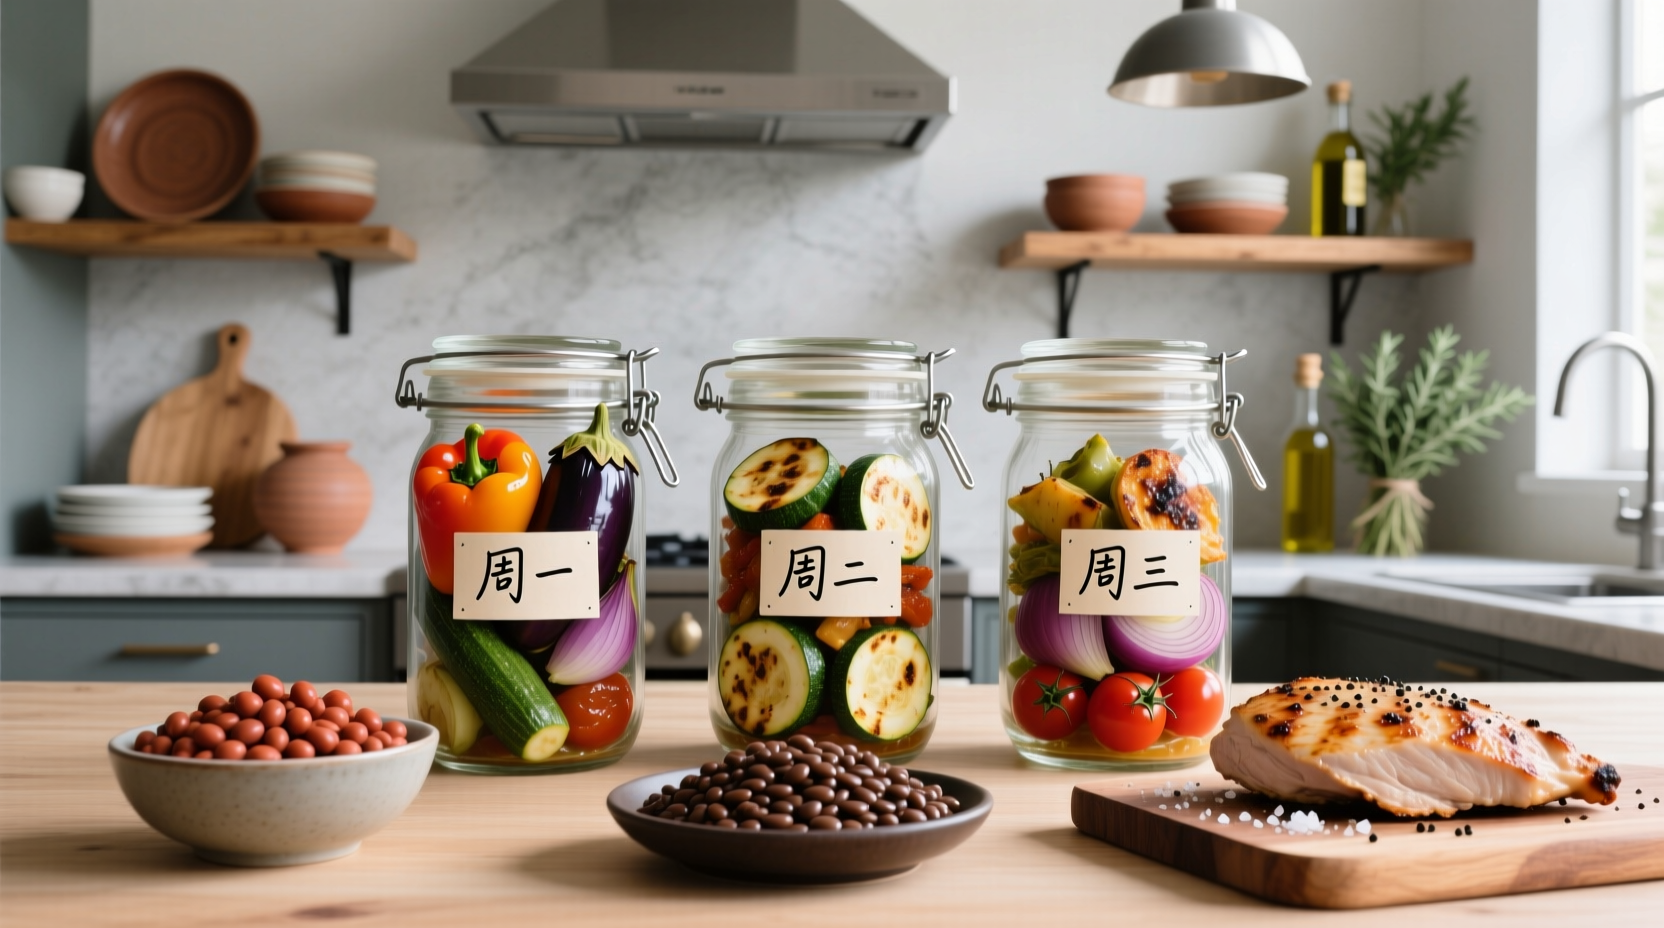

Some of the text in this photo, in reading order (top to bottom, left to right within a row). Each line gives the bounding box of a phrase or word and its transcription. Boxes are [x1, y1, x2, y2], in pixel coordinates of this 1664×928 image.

[475, 546, 573, 604] 周一
[778, 545, 879, 602] 周二
[1078, 545, 1179, 601] 周三
